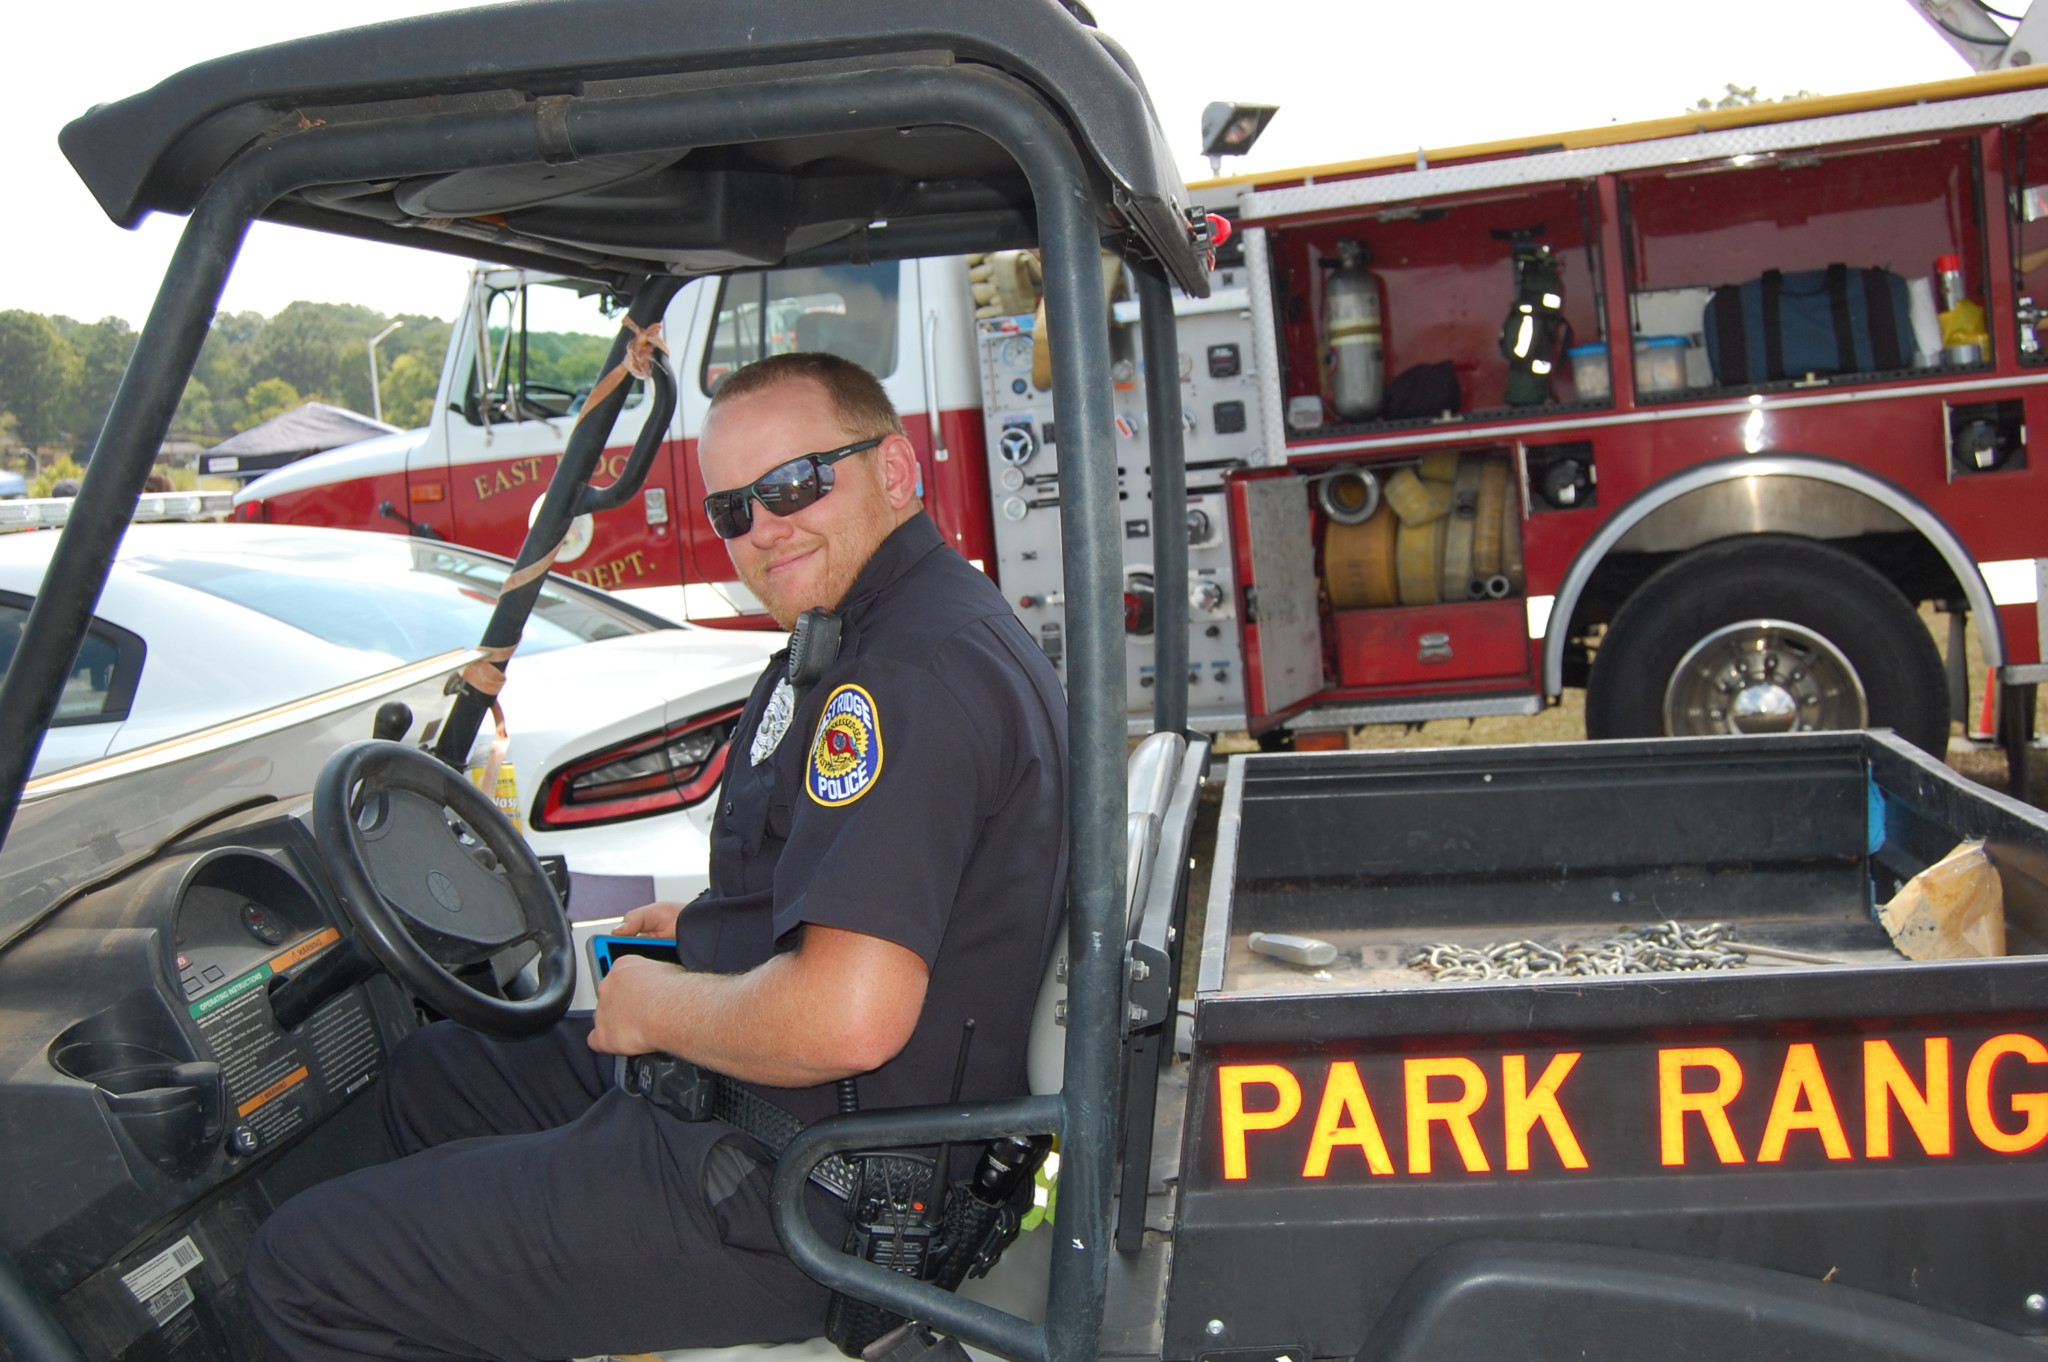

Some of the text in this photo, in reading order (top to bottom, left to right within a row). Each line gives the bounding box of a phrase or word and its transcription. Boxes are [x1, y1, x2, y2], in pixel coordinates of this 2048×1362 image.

[474, 457, 542, 500] EAST
[571, 551, 656, 588] DEPT.
[818, 761, 869, 800] POLICE
[199, 990, 229, 1011] OPERATING
[228, 972, 263, 995] INSTRUCTIONS
[1219, 1034, 2048, 1179] PARK RANG
